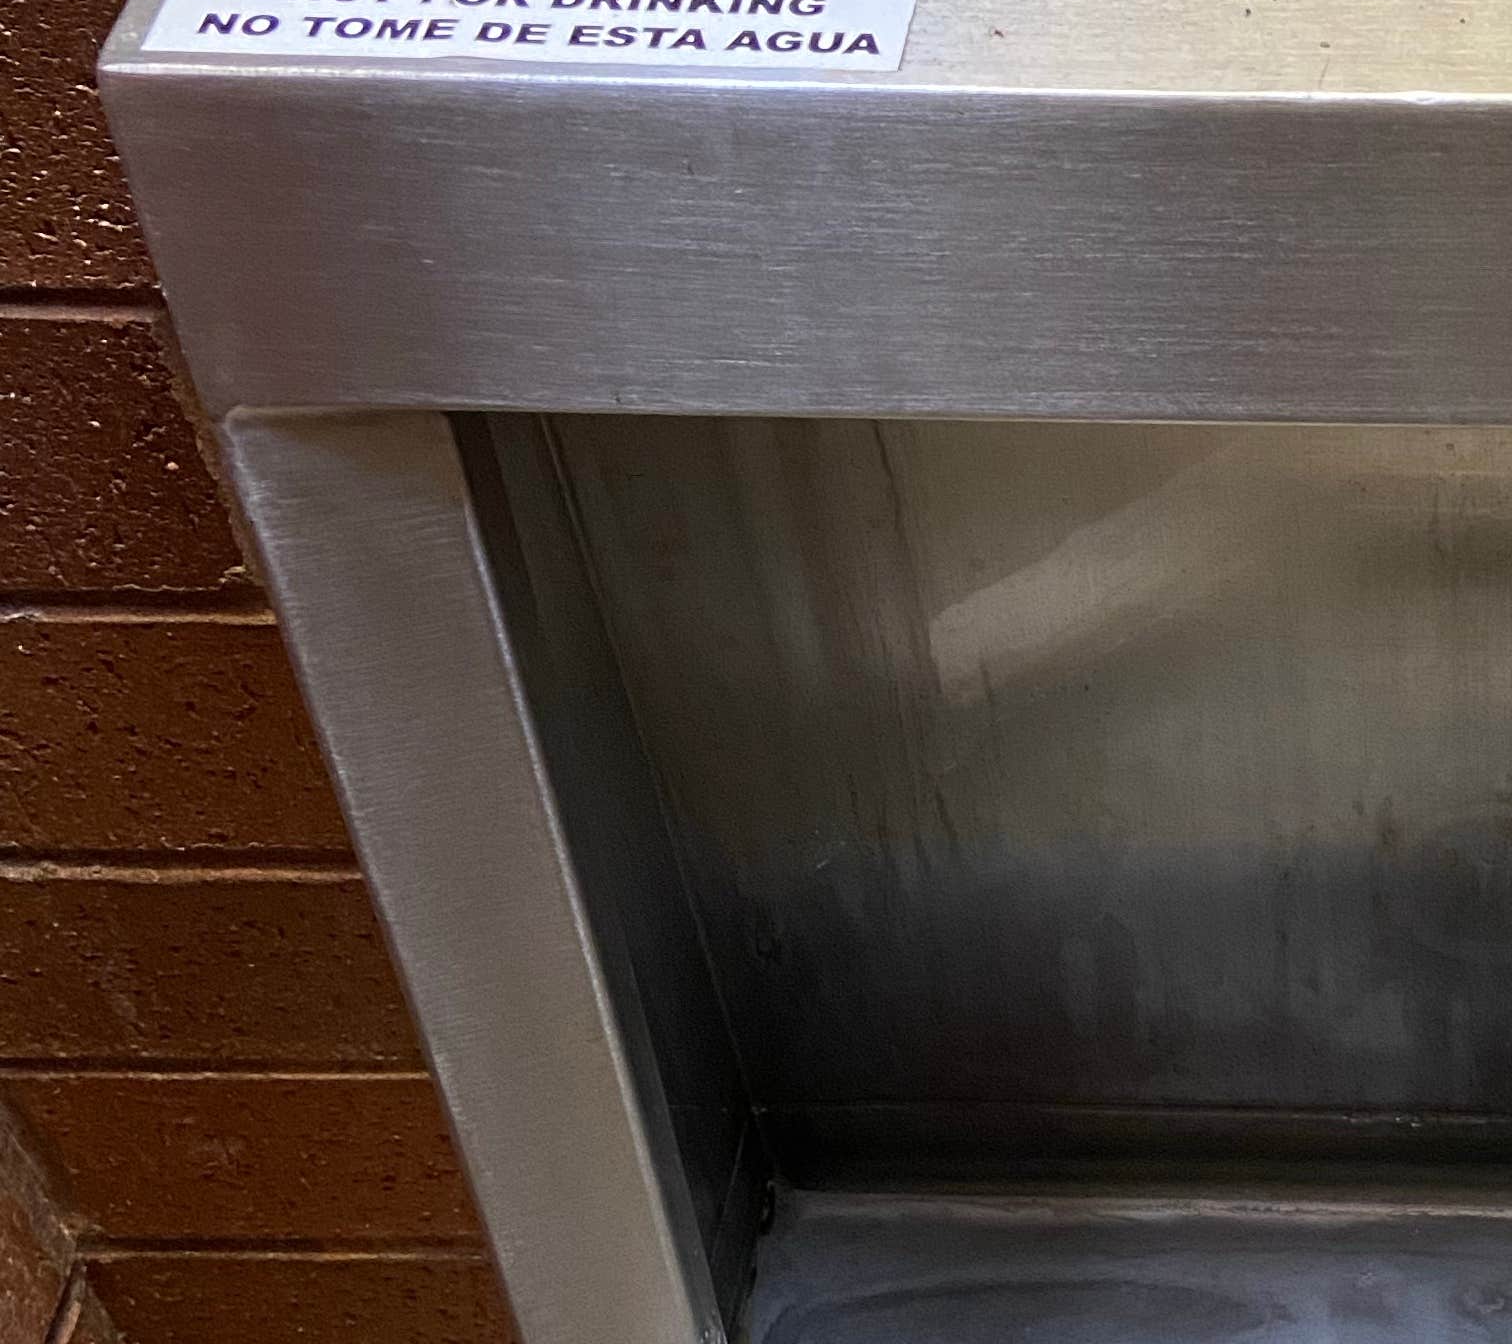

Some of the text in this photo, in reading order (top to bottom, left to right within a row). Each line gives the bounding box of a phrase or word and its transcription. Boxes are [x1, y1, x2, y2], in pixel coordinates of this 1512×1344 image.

[196, 13, 881, 56] NO TOME DE ESTA AGUA
